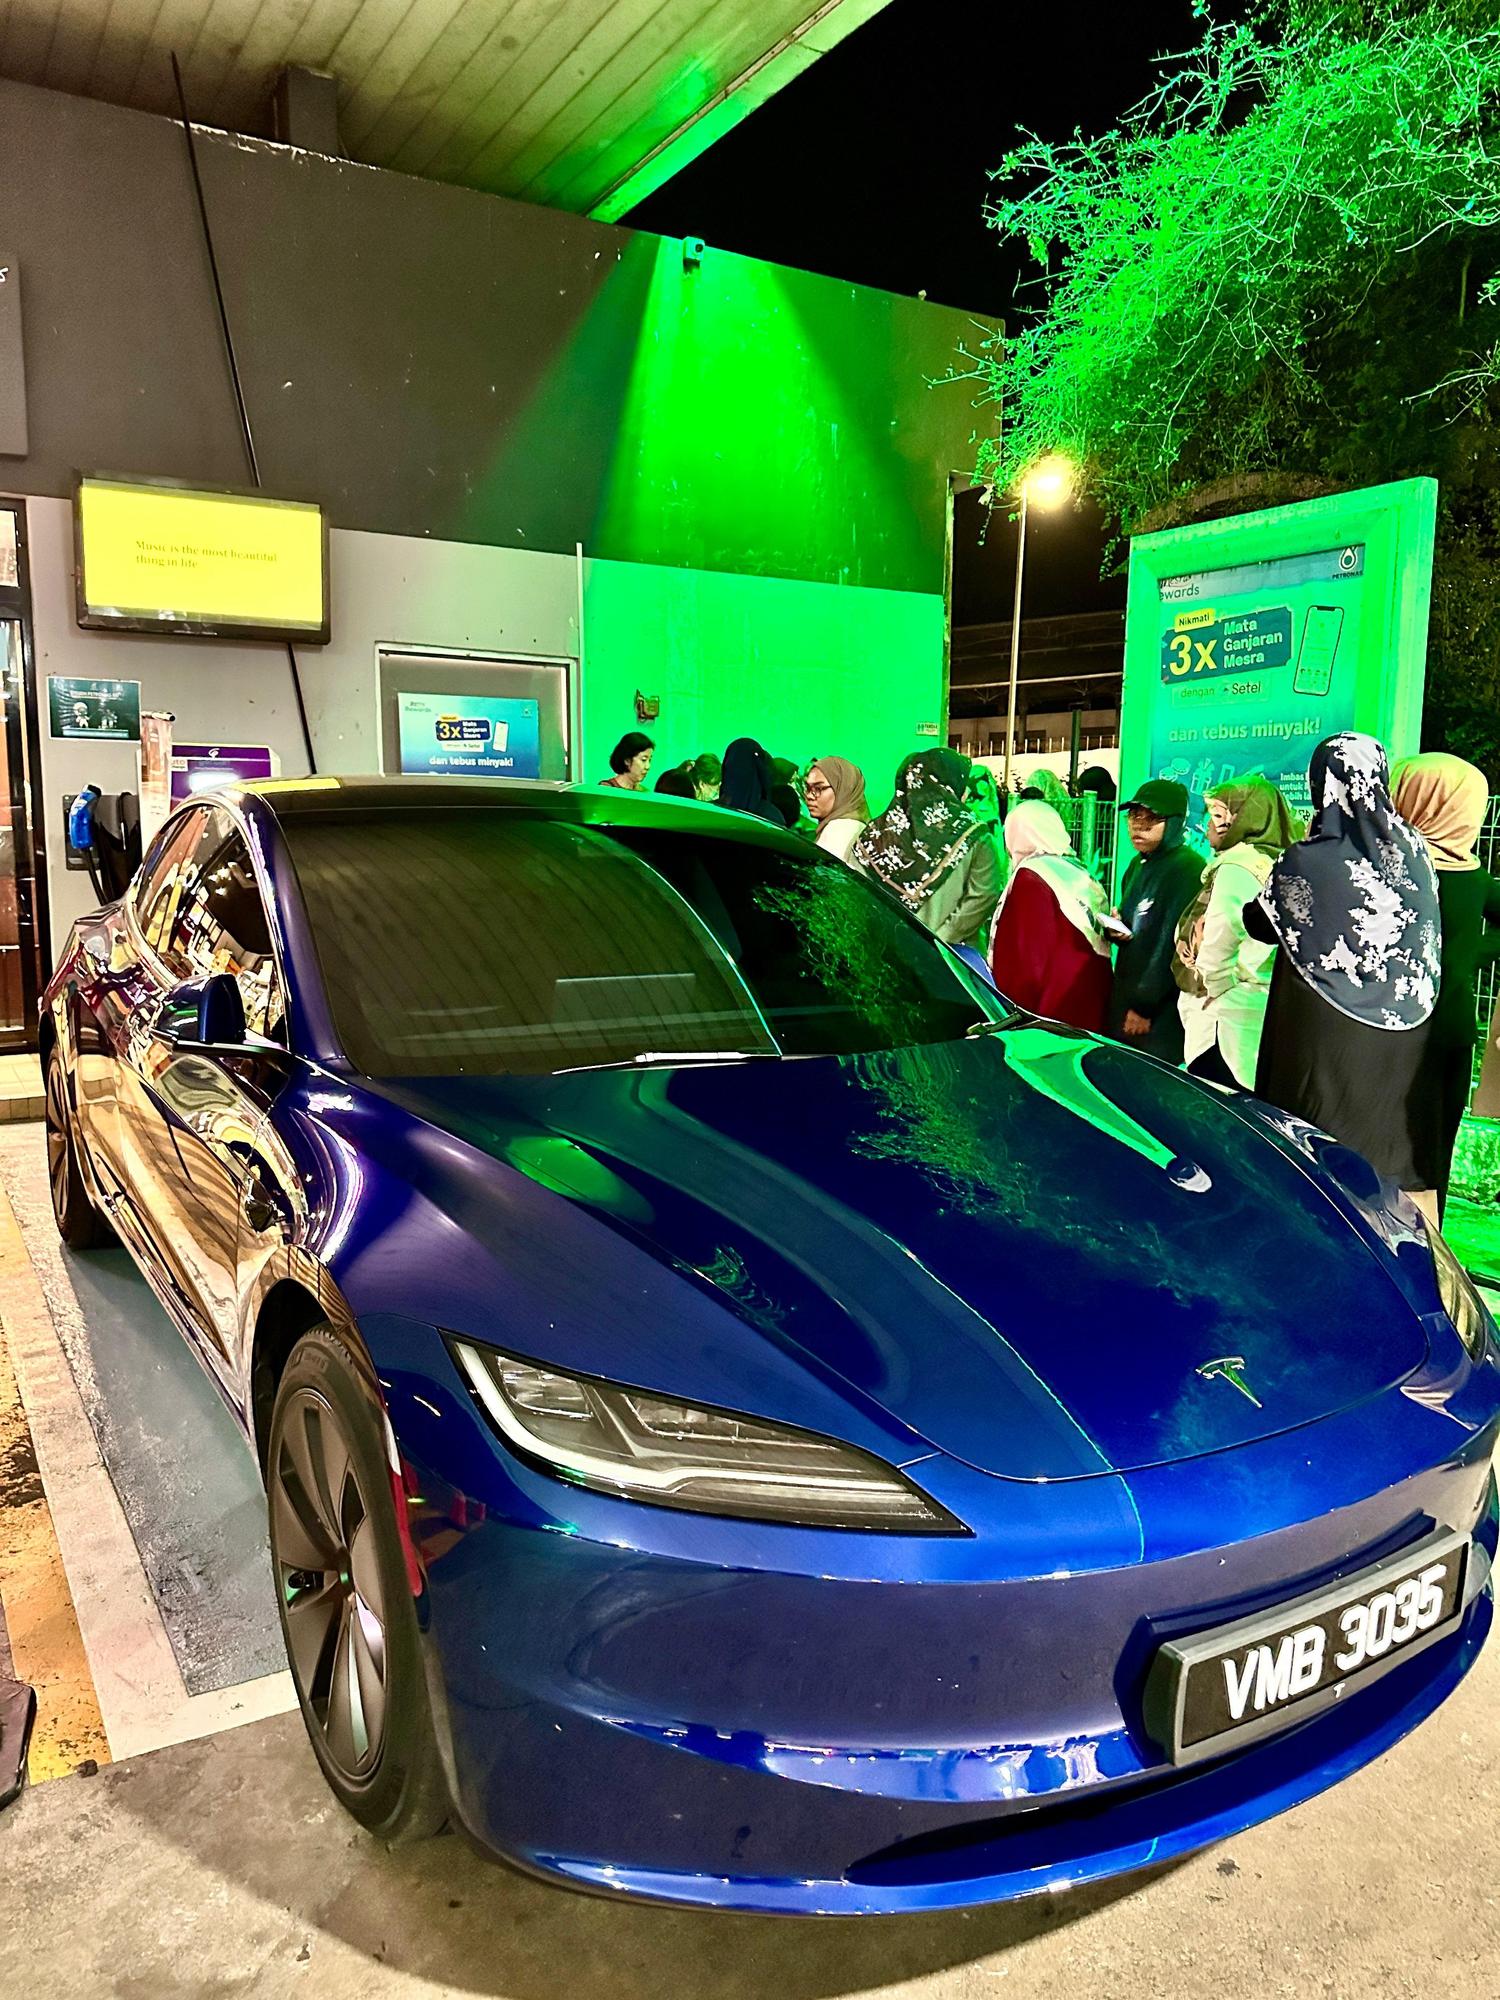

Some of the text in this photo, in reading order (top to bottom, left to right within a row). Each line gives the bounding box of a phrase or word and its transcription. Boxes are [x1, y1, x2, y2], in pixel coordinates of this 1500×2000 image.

[136, 540, 277, 562] Music is the most beautiful
[136, 554, 198, 568] thing in life
[1178, 613, 1210, 626] Nikmati
[1223, 618, 1258, 636] Mata
[1223, 631, 1283, 652] Ganjaran
[1169, 634, 1218, 676] 3x
[1223, 651, 1265, 669] Mesra
[1180, 681, 1261, 699] dengan Setel
[438, 722, 462, 739] 3x
[1168, 717, 1321, 742] dan tebus minyak!
[429, 756, 514, 769] dan tebus minyak!
[1280, 772, 1305, 781] Imbas
[1279, 781, 1304, 791] untuk
[1221, 1563, 1447, 1720] VMB 3035
